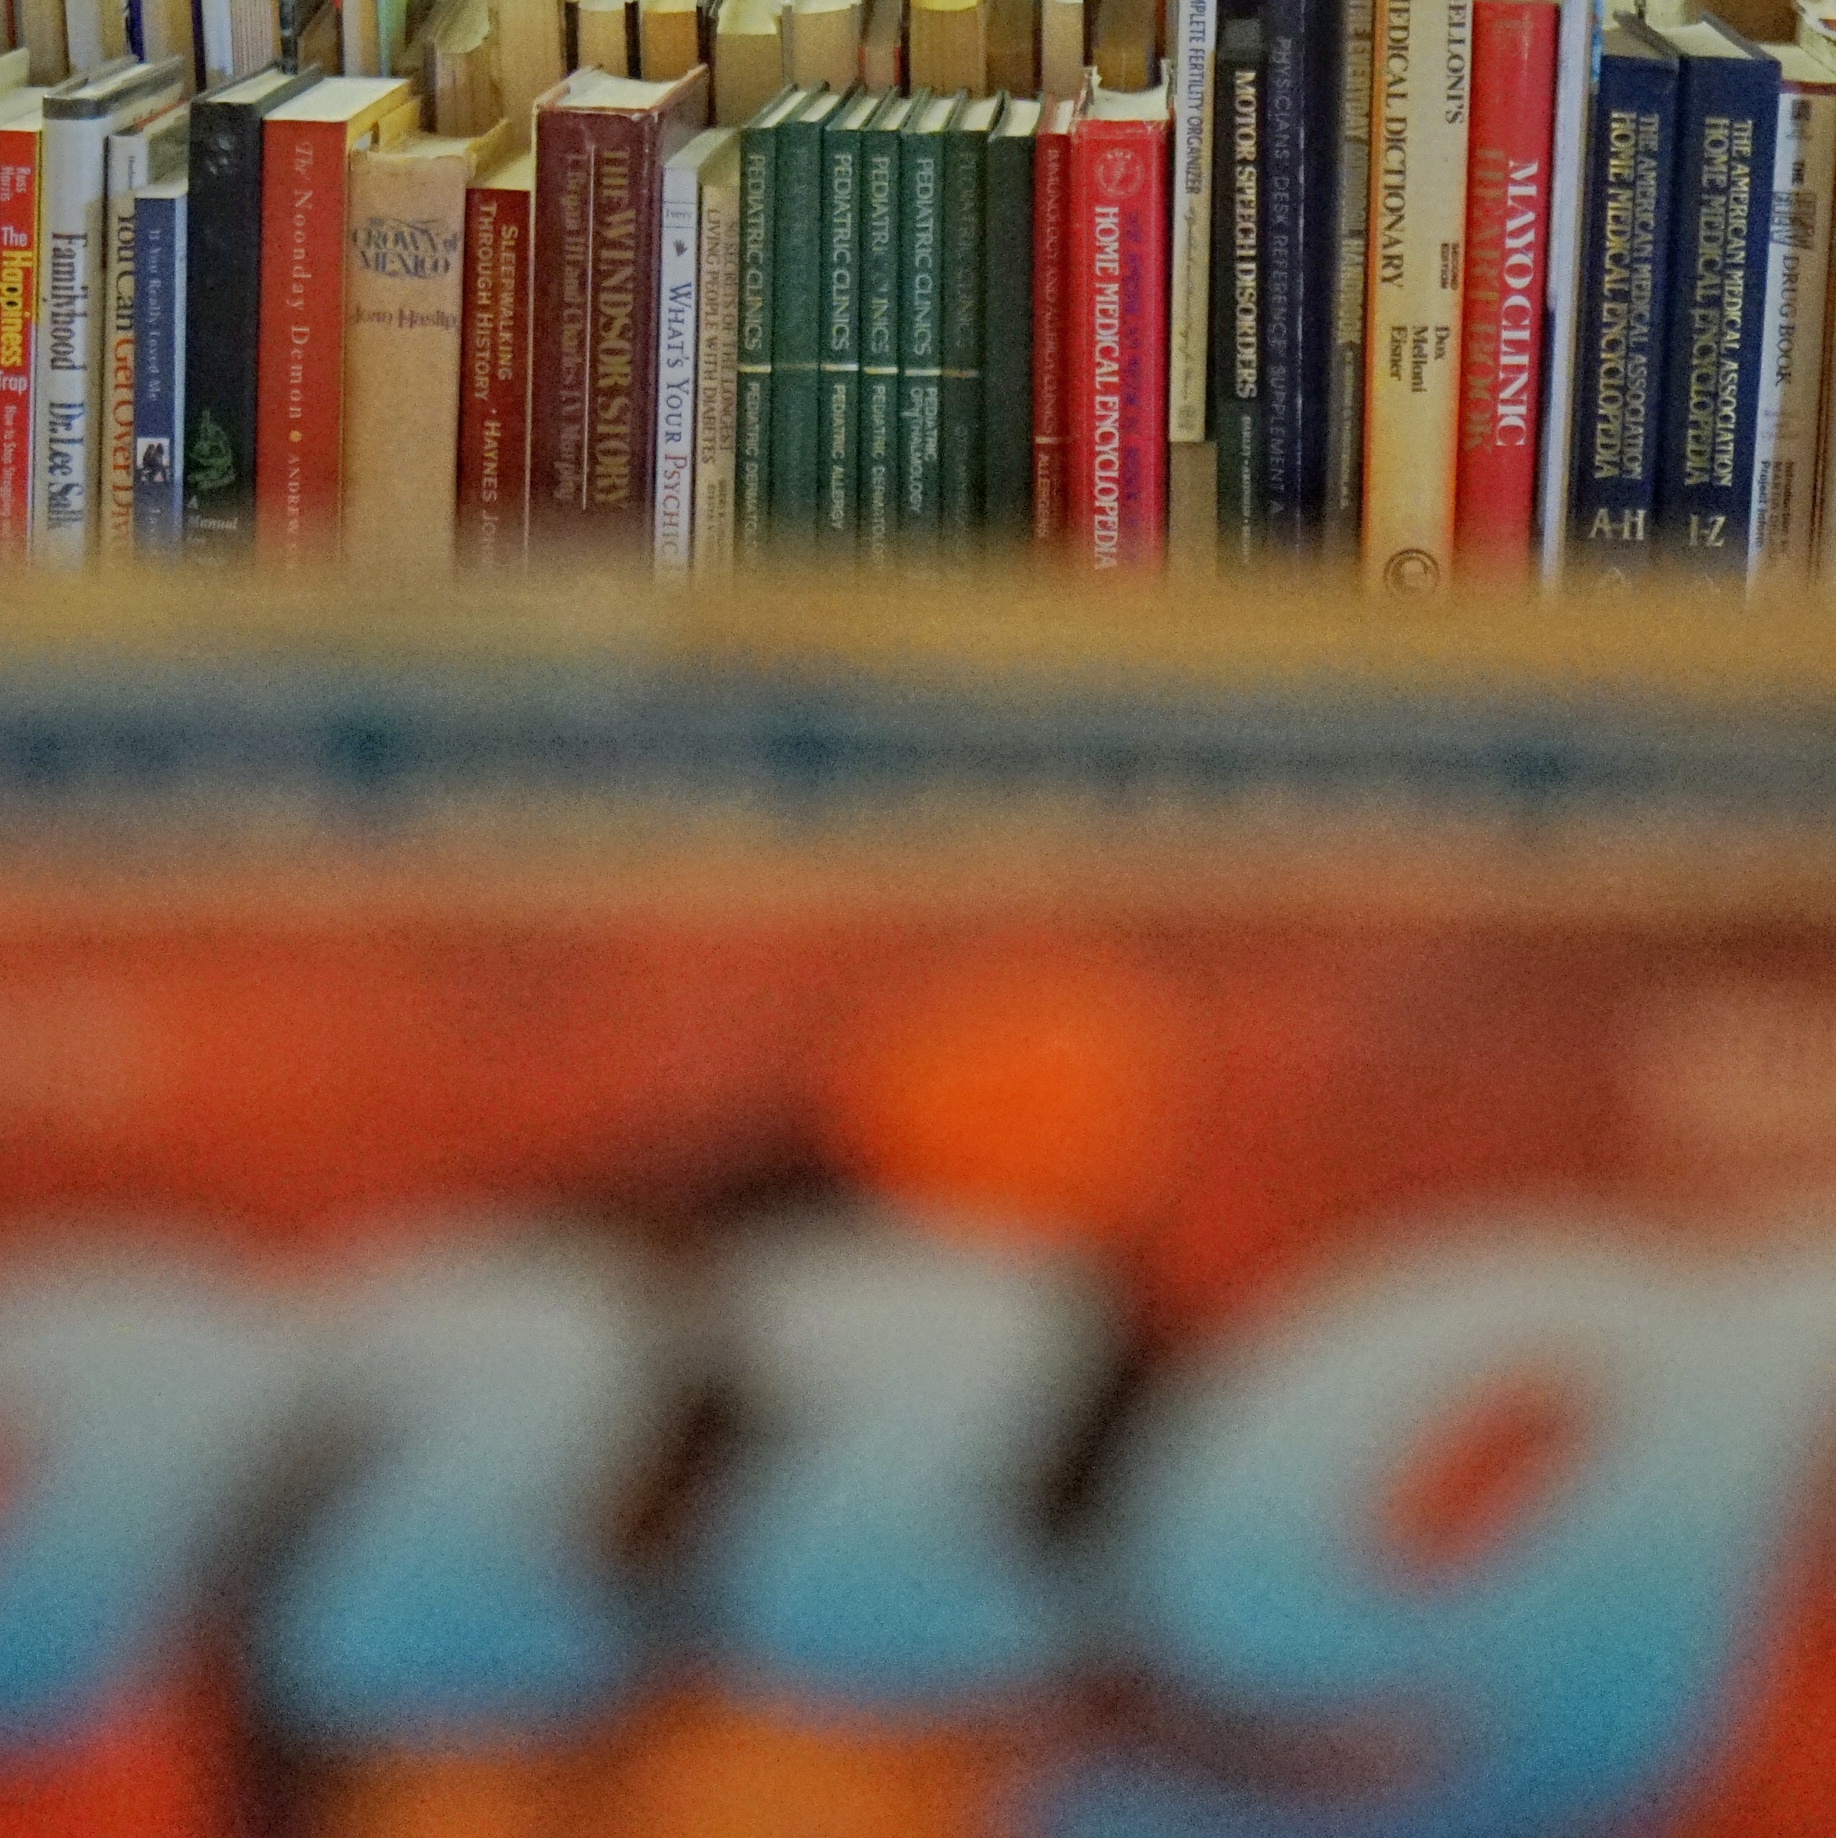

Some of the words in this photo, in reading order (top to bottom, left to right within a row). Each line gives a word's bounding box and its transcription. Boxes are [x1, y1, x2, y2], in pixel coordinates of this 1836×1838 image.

[1187, 48, 1206, 111] FERTILITY
[1235, 70, 1256, 161] MOTOR
[1185, 116, 1204, 195] ORGANIZER
[1610, 111, 1636, 182] HOME
[1638, 114, 1660, 152] THE
[1704, 117, 1729, 186] HOME
[1731, 120, 1752, 158] THE
[1, 226, 27, 247] The
[704, 208, 721, 265] LIVING
[743, 154, 763, 264] PEDIATRIC
[831, 154, 852, 263] PEDIATRIC
[913, 159, 935, 267] PEDIATRIC
[1094, 206, 1121, 275] HOME
[1234, 165, 1255, 258] SPEECH
[1381, 116, 1409, 288] DICTIONARY
[1503, 160, 1540, 289] MAYO
[1604, 188, 1632, 297] MEDICAL
[1634, 157, 1658, 257] AMERICAN
[1726, 161, 1750, 264] AMERICAN
[285, 189, 314, 312] Noonday
[476, 202, 497, 305] THROUGH
[1696, 194, 1726, 301] MEDICAL
[1779, 254, 1801, 318] DRUG
[44, 231, 88, 372] Familyhood
[116, 270, 135, 332] Can
[497, 224, 519, 381] SLEEPWALKING
[596, 208, 637, 387] WINDSOR
[666, 281, 693, 369] WHAT'S
[704, 270, 720, 339] PEOPLE
[743, 269, 763, 352] CLINICS
[831, 269, 852, 350] CLINICS
[913, 274, 935, 355] CLINICS
[1093, 283, 1119, 390] MEDICAL
[1233, 263, 1254, 399] DISORDERS
[1630, 263, 1653, 346] MEDICAL
[1722, 270, 1745, 351] MEDICAL
[113, 337, 135, 391] Get
[289, 325, 311, 420] Demon
[474, 311, 494, 401] HISTORY
[703, 344, 719, 381] WITH
[1390, 325, 1407, 381] Eisner
[1495, 294, 1533, 447] CLINIC
[1594, 303, 1627, 480] ENCYCLOPEDIA
[1775, 323, 1797, 388] BOOK
[113, 402, 135, 473] Over
[664, 377, 690, 444] YOUR
[831, 384, 845, 459] PEDIATRIC
[924, 388, 938, 461] PEDIATRIC
[1624, 352, 1648, 480] ASSOCIATION
[1685, 308, 1723, 485] ENCYCLOPEDIA
[1713, 360, 1738, 487] ASSOCIATION
[481, 420, 502, 502] HAYNES
[1092, 395, 1118, 570] ENCYCLOPEDIA
[1590, 508, 1645, 542] A-H
[1690, 514, 1726, 547] I-Z
